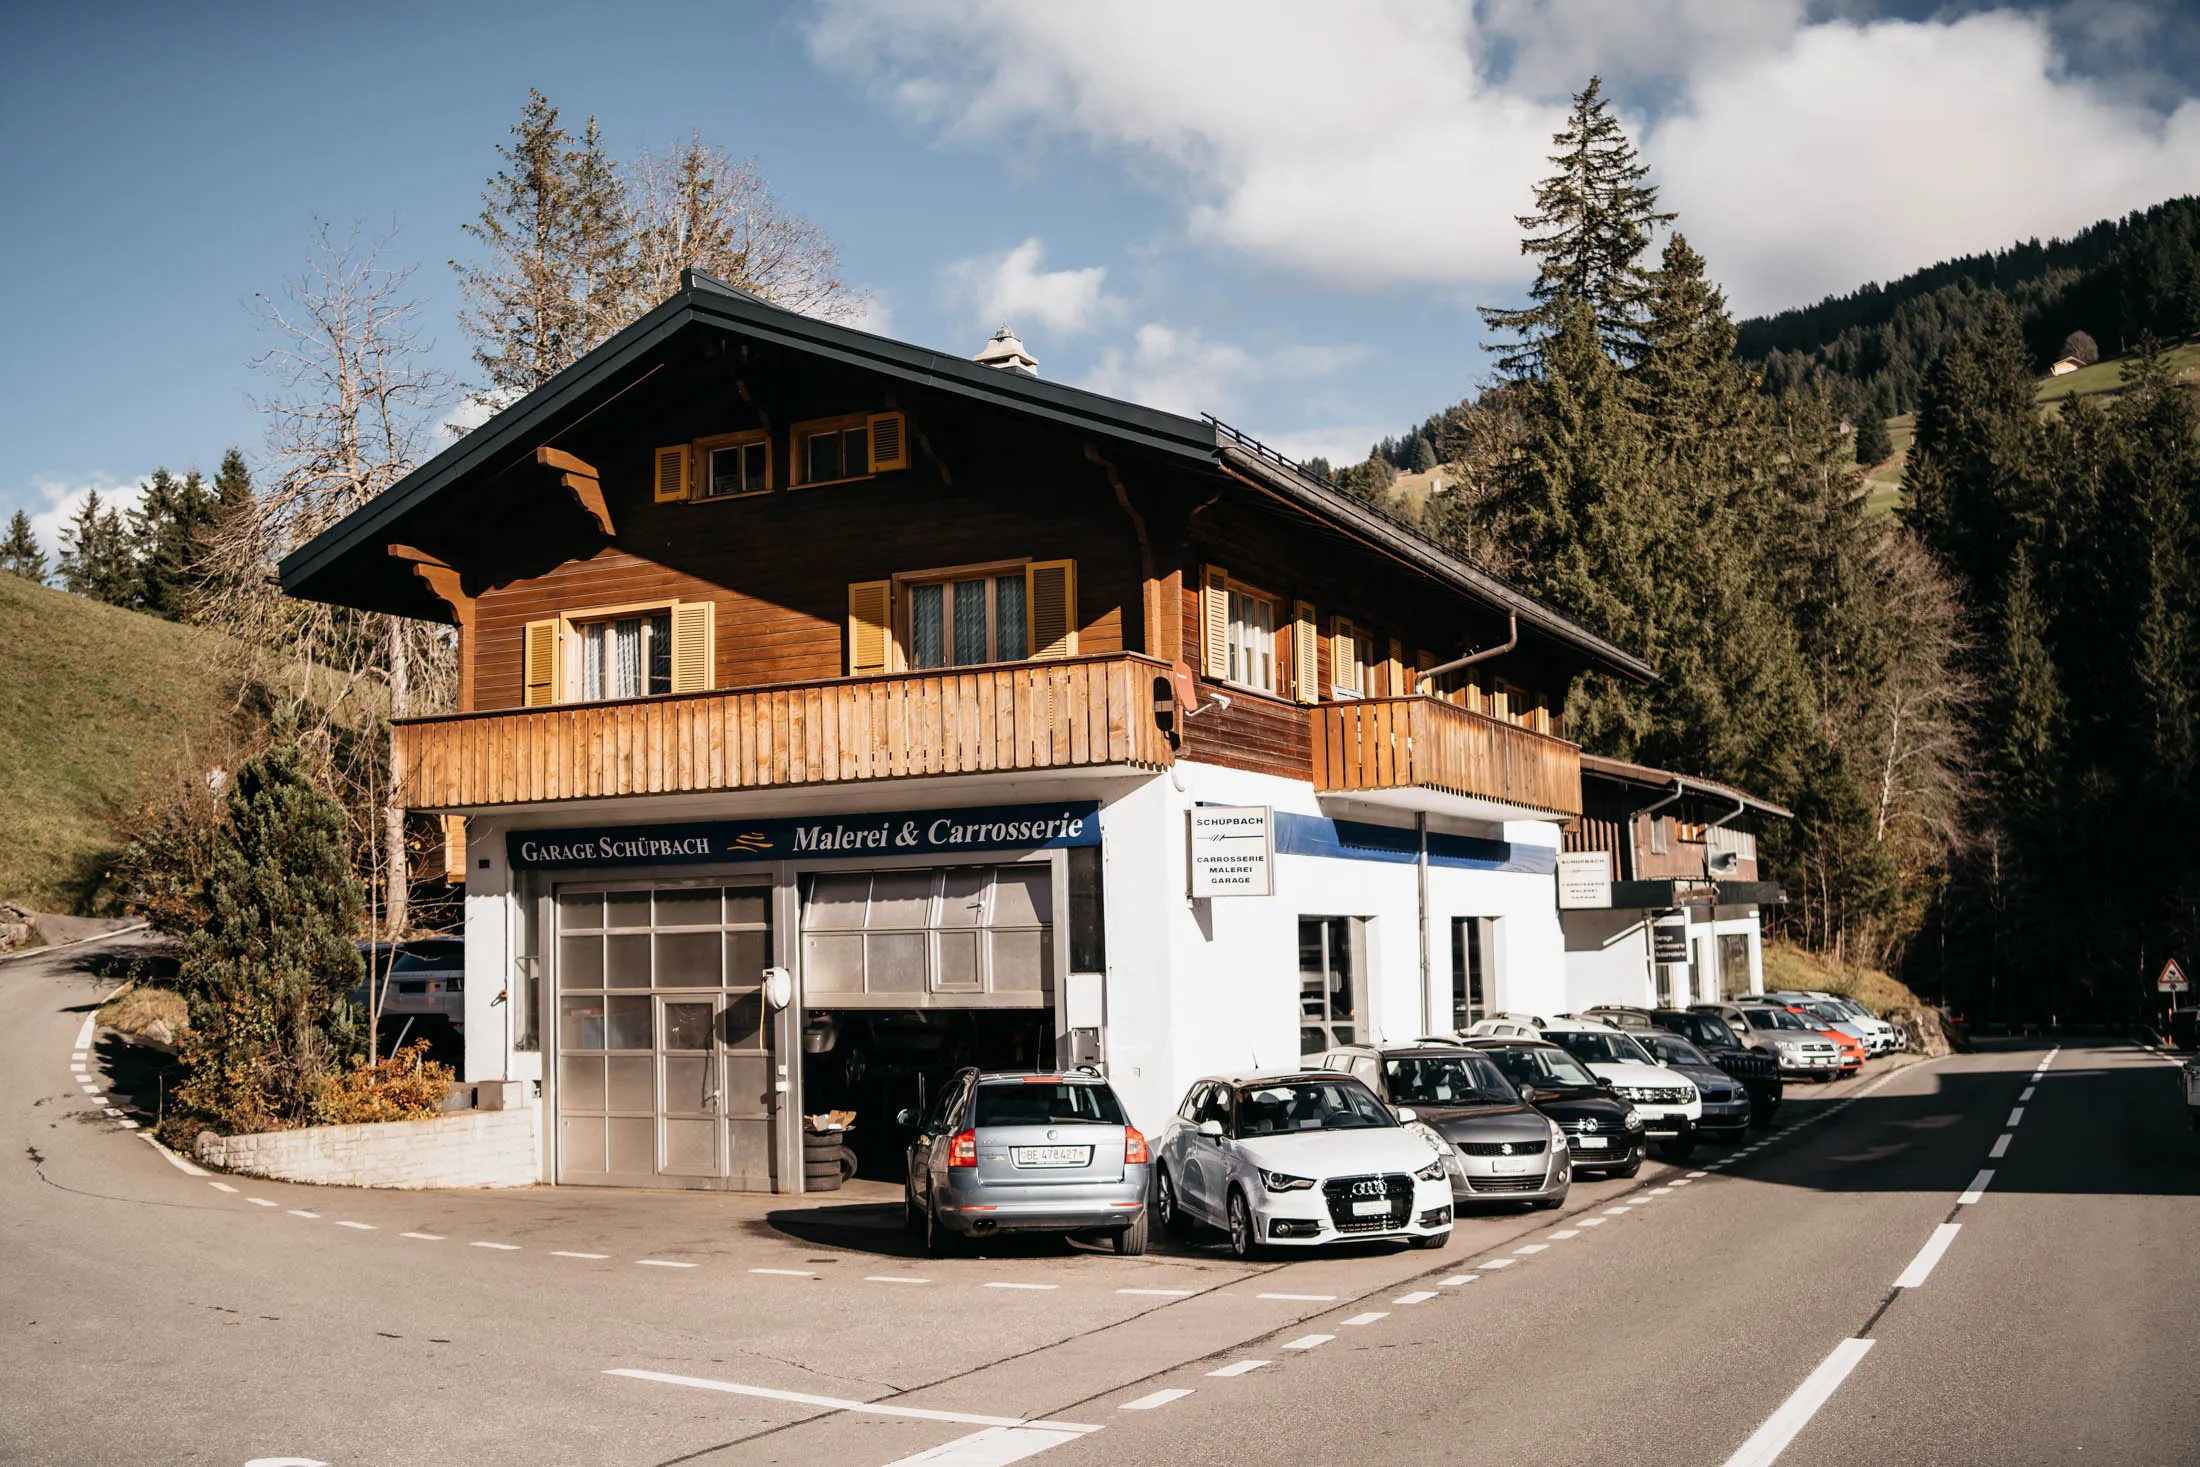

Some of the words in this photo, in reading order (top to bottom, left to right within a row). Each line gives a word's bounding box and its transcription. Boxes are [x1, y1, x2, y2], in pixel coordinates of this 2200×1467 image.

[792, 822, 889, 851] Malerei
[894, 820, 919, 847] &
[927, 811, 1083, 845] Carrosserie
[1026, 1150, 1038, 1161] BE
[1042, 1149, 1077, 1160] 478427
